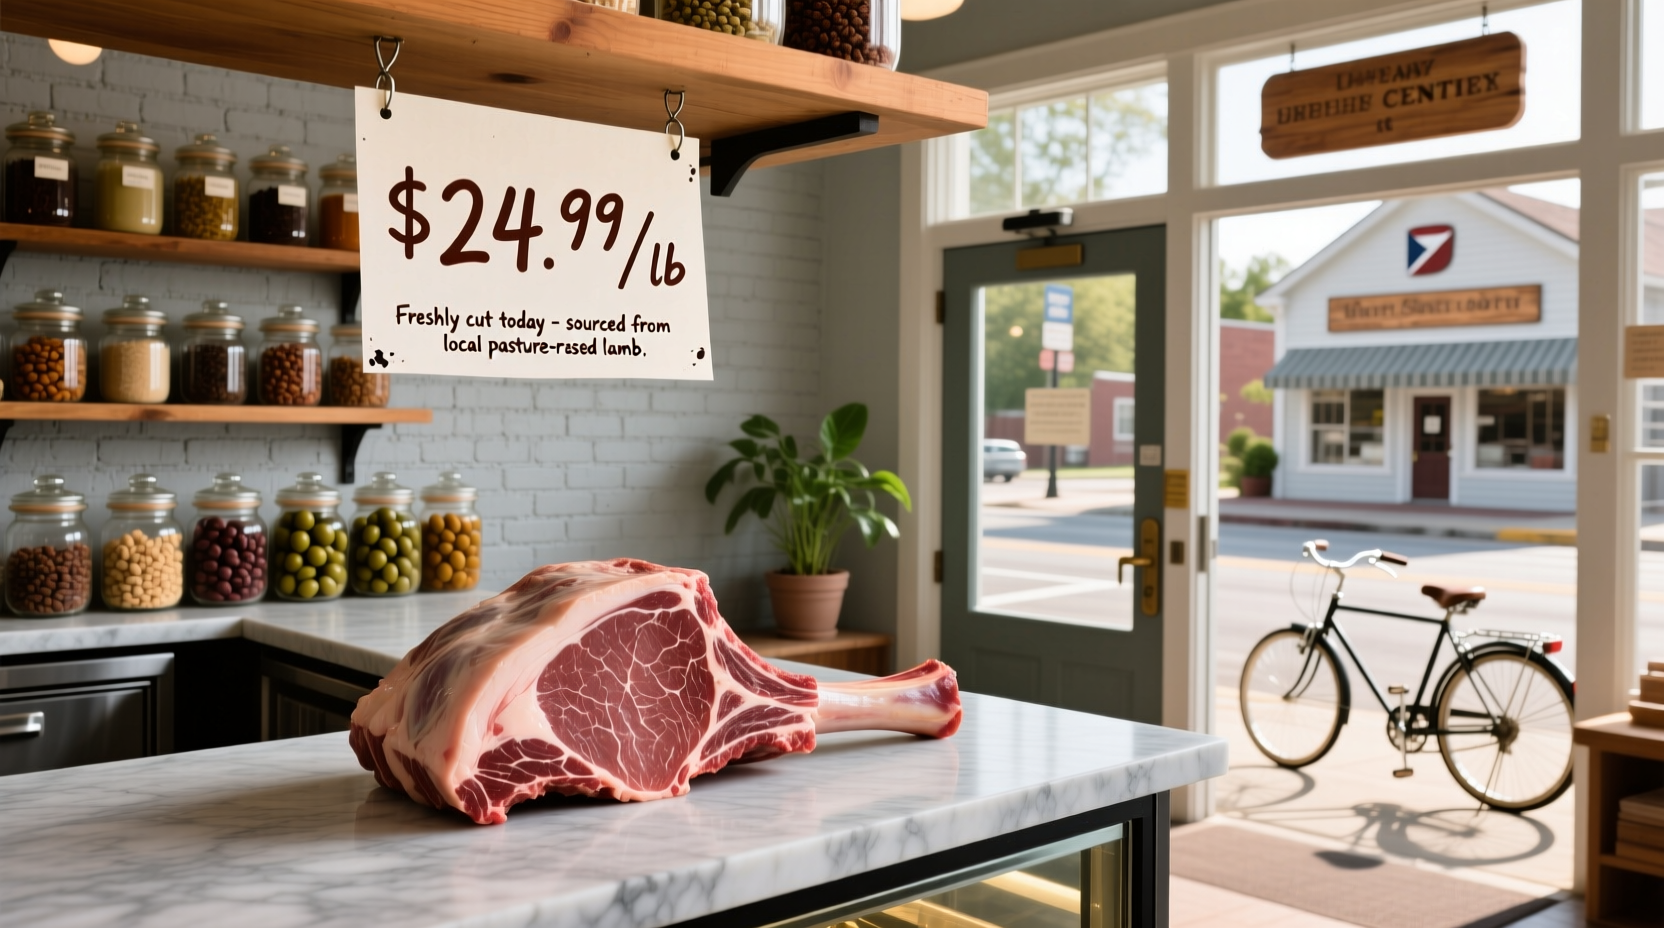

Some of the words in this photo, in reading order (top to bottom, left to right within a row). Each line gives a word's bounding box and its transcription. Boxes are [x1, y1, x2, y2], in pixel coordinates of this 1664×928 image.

[388, 165, 686, 290] $24.99/lb
[396, 303, 460, 334] Freshly
[465, 310, 494, 328] cut
[498, 309, 545, 337] today
[565, 313, 626, 333] sourced
[630, 313, 671, 333] from
[443, 333, 482, 353] local
[602, 336, 647, 357] lamb.
